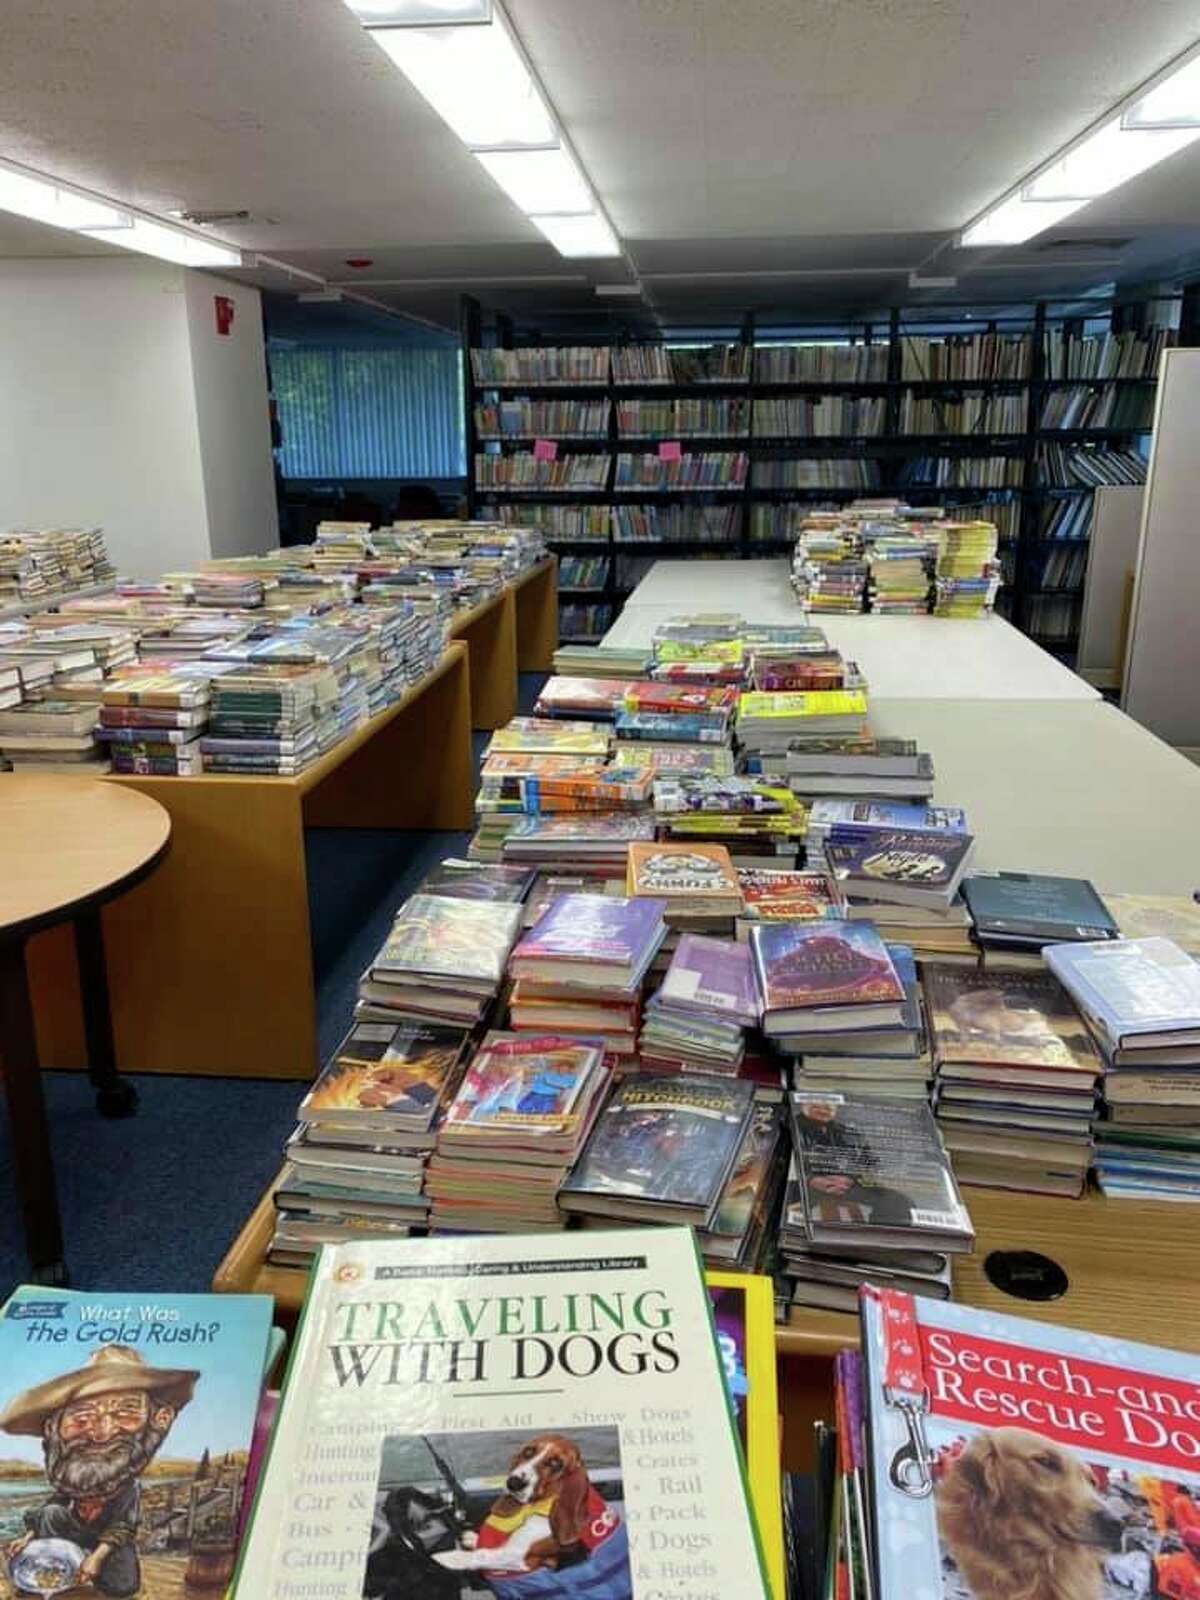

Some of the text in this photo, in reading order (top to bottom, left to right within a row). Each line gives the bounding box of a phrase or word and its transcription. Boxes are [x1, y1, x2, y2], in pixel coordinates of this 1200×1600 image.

[522, 1258, 600, 1273] Understanding
[601, 1257, 640, 1270] Library
[79, 1304, 180, 1321] What Was
[336, 1290, 672, 1342] TRAVELING
[25, 1321, 221, 1344] the Gold Rush?
[329, 1339, 489, 1388] WITH
[512, 1331, 680, 1381] DOGS
[440, 1414, 486, 1431] First
[500, 1412, 533, 1427] Aid
[571, 1407, 626, 1424] Show
[639, 1406, 692, 1423] Dogs
[932, 1366, 1200, 1457] Rescue Do
[638, 1426, 695, 1446] Hotels
[636, 1455, 699, 1470] Crates
[293, 1475, 703, 1512] Car & Rail
[289, 1522, 333, 1539] Bus
[649, 1504, 708, 1522] Pack
[649, 1531, 713, 1554] Dogs
[660, 1560, 718, 1578] Hotels
